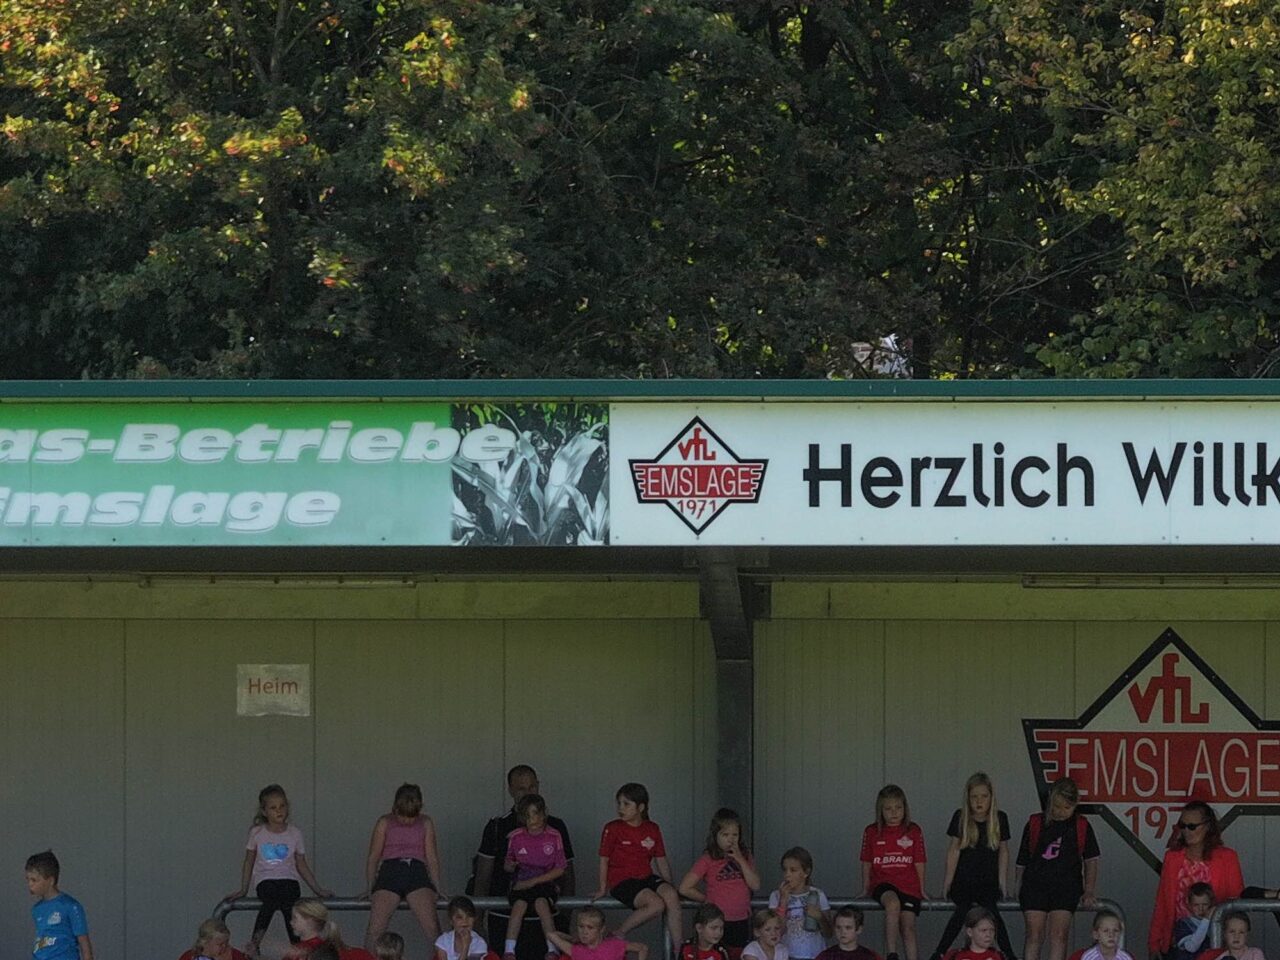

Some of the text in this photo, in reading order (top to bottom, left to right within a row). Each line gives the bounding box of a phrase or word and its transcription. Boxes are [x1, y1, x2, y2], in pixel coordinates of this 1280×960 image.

[0, 422, 516, 464] as-Betriebe
[645, 467, 752, 497] EMSLAGE
[803, 441, 1095, 508] Herzlich
[0, 485, 342, 533] mslage
[677, 499, 717, 519] 1971
[248, 677, 298, 696] Heim
[1064, 738, 1280, 797] EMSLAGE
[1124, 805, 1184, 848] 197
